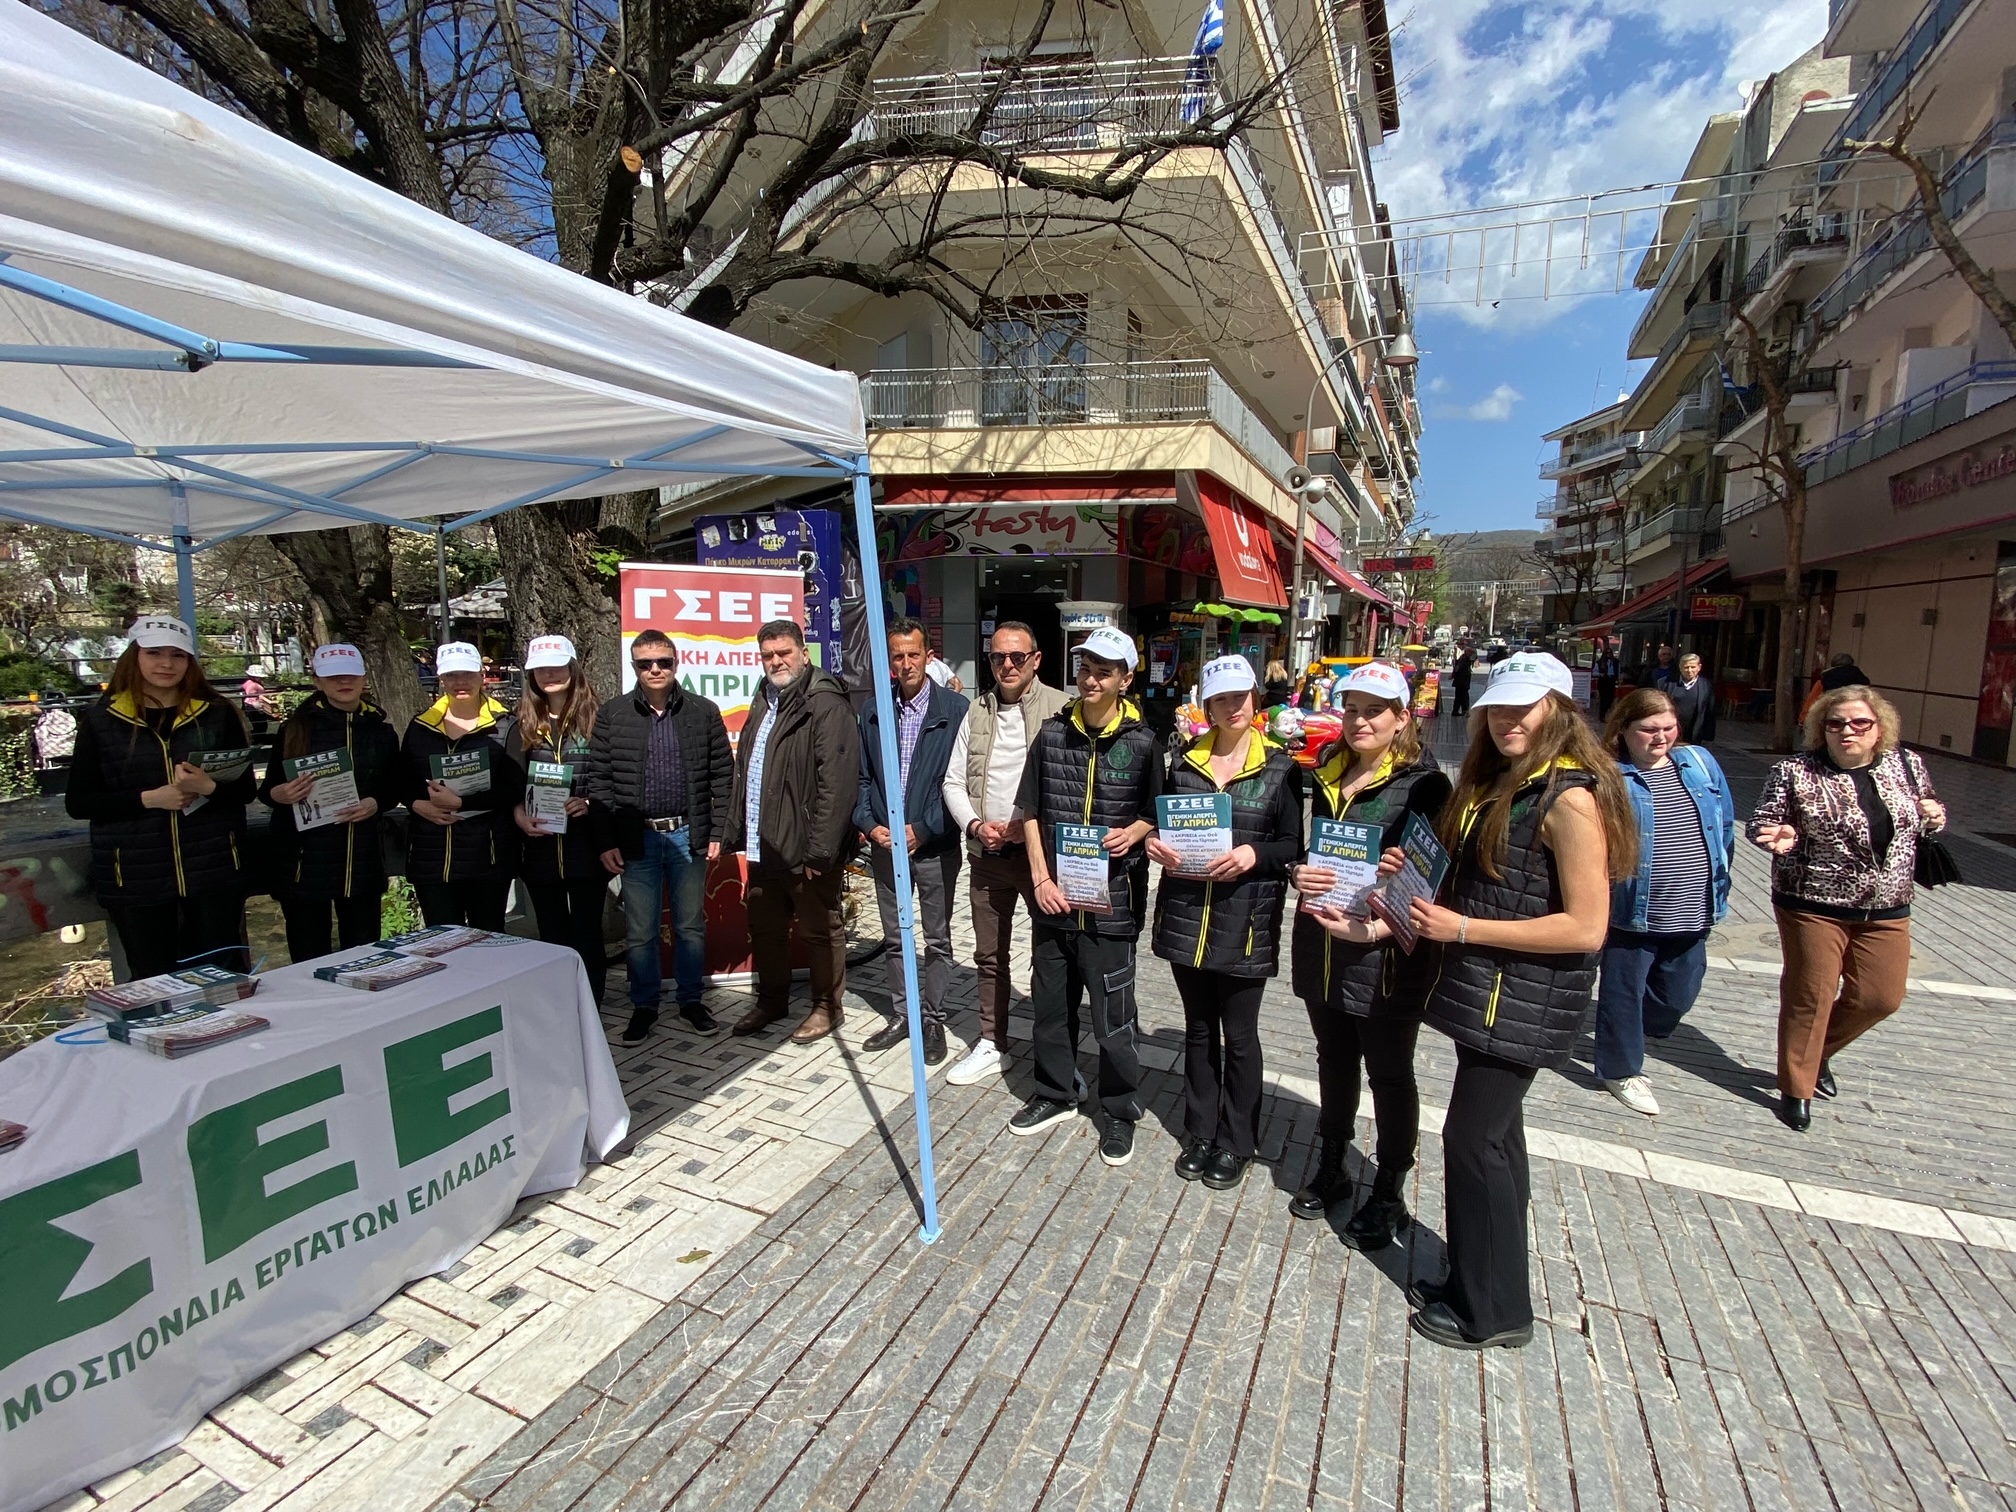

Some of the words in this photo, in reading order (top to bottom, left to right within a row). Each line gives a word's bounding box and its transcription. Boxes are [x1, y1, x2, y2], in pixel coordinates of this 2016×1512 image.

[972, 506, 1076, 543] tasty
[728, 557, 756, 568] Μικρών
[634, 587, 793, 623] ΓΣΕΕ
[1696, 597, 1737, 606] ΓΥΡΟΣ
[146, 621, 188, 636] ΓΣΕΕ
[1090, 630, 1123, 645] ΓΣΕΕ
[441, 648, 473, 658] ΓΣΕΕ
[531, 643, 561, 652] ΓΣΕΕ
[321, 650, 357, 659] ΓΣΕΕ
[1206, 662, 1242, 677] ΓΣΕΕ
[1351, 669, 1391, 682] ΓΣΕΕ
[1491, 662, 1537, 679] ΓΣΕΕ
[294, 751, 338, 767] ΓΣΕΕ
[441, 751, 480, 765] ΓΣΕΕ
[536, 763, 564, 772] ΓΣΕΕ
[1104, 771, 1131, 780] ΓΣΕΕ
[1167, 797, 1214, 809] ΓΣΕΕ
[1183, 819, 1217, 827] ΑΠΡΙΛΗ
[1063, 826, 1098, 838] ΓΣΕΕ
[1322, 822, 1368, 839] ΓΣΕΕ
[1323, 839, 1344, 847] ΓΕΝΙΚΗ
[1344, 842, 1368, 851] ΑΠΕΡΓΙΑ
[1412, 822, 1439, 857] ΓΣΕΕ
[1066, 846, 1073, 854] 17
[1073, 847, 1099, 856] ΑΠΡΙΛΗ
[1323, 845, 1330, 853] 17
[1333, 847, 1367, 859] ΑΠΡΙΛΗ
[1322, 859, 1344, 868] ΑΚΡΙΒΕΙΑ
[1411, 852, 1431, 878] ΑΠΡΙΛΗ
[0, 1277, 246, 1433] ΜΟΣΠΟΝΔΙΑ
[255, 1198, 399, 1290] ΕΡΓΑΤΩΝ
[406, 1134, 516, 1215] ΕΛΛΑΔΑΣ
